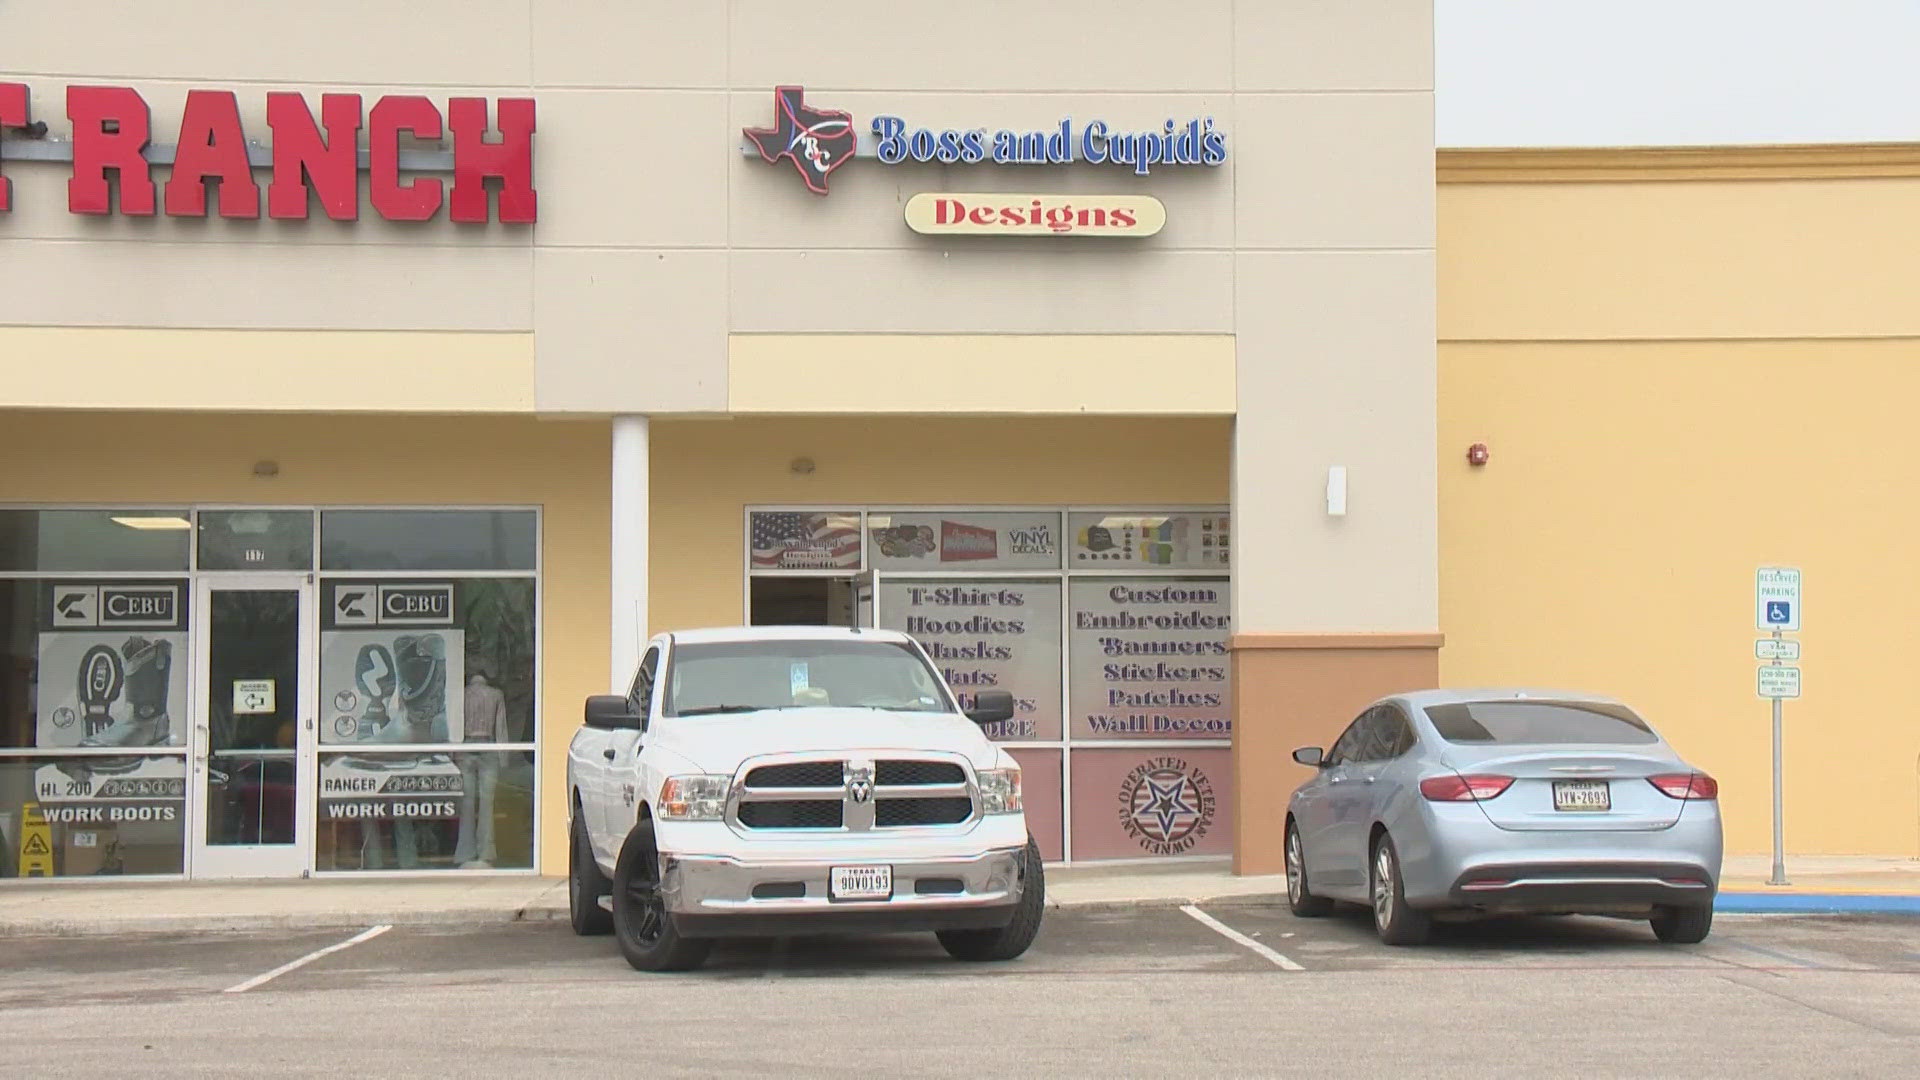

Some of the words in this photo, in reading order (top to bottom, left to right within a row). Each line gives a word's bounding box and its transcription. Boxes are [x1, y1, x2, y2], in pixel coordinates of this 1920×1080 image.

[871, 115, 985, 165] Boss
[992, 114, 1073, 164] and
[1082, 115, 1228, 175] Cupid's
[66, 85, 537, 224] RANCH
[935, 199, 1138, 232] Designs
[1009, 531, 1053, 545] VINYL
[1012, 544, 1048, 555] DECALS
[1759, 573, 1798, 583] RESERVED
[907, 586, 1025, 606] T-Shirts
[1109, 585, 1218, 604] Custom
[1761, 587, 1796, 597] PARKING
[906, 615, 1025, 634] Hoodies
[1076, 611, 1231, 630] Embroider
[919, 641, 1012, 659] Masks
[1099, 637, 1231, 656] Banners
[1104, 662, 1226, 682] Stickers
[1108, 687, 1221, 707] Patches
[982, 719, 1036, 738] ORE
[1087, 714, 1148, 733] Wall
[66, 782, 92, 796] 200
[325, 778, 377, 792] RANGER
[1118, 756, 1187, 803] OPERATED
[329, 803, 386, 818] WORK
[393, 801, 456, 817] BOOTS
[1191, 767, 1216, 838] VETERAN
[43, 807, 103, 823] WORK
[110, 806, 176, 821] BOOTS
[1118, 808, 1141, 839] AND
[1140, 836, 1195, 855] OWNED
